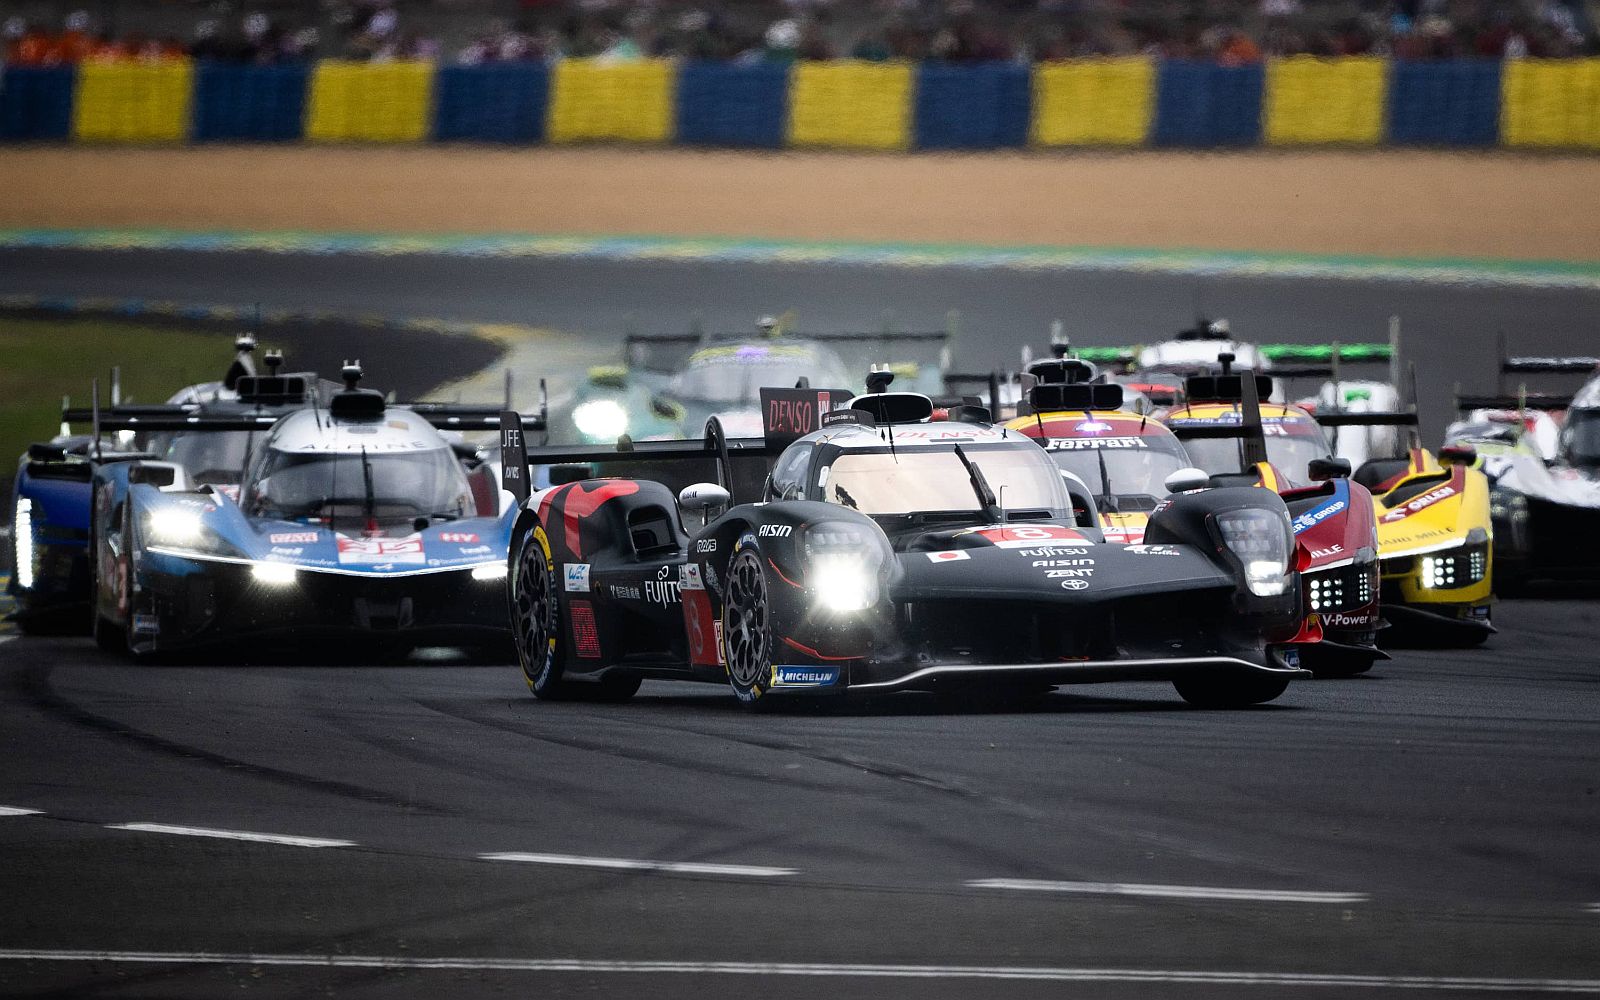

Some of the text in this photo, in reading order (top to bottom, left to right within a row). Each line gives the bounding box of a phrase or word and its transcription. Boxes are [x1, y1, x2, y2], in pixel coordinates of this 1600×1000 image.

[769, 399, 812, 433] DENSO
[502, 429, 520, 448] JFE
[1044, 436, 1148, 450] Ferrari
[1408, 486, 1455, 511] ORLEN
[1313, 501, 1345, 520] GROUP
[758, 524, 792, 537] AISIN
[1012, 528, 1052, 539] 8
[1019, 547, 1089, 557] FUJITSU
[1032, 558, 1095, 567] AISIN
[1044, 568, 1094, 578] ZENT
[1322, 613, 1369, 626] V-Power
[784, 672, 833, 681] MICHELIN
